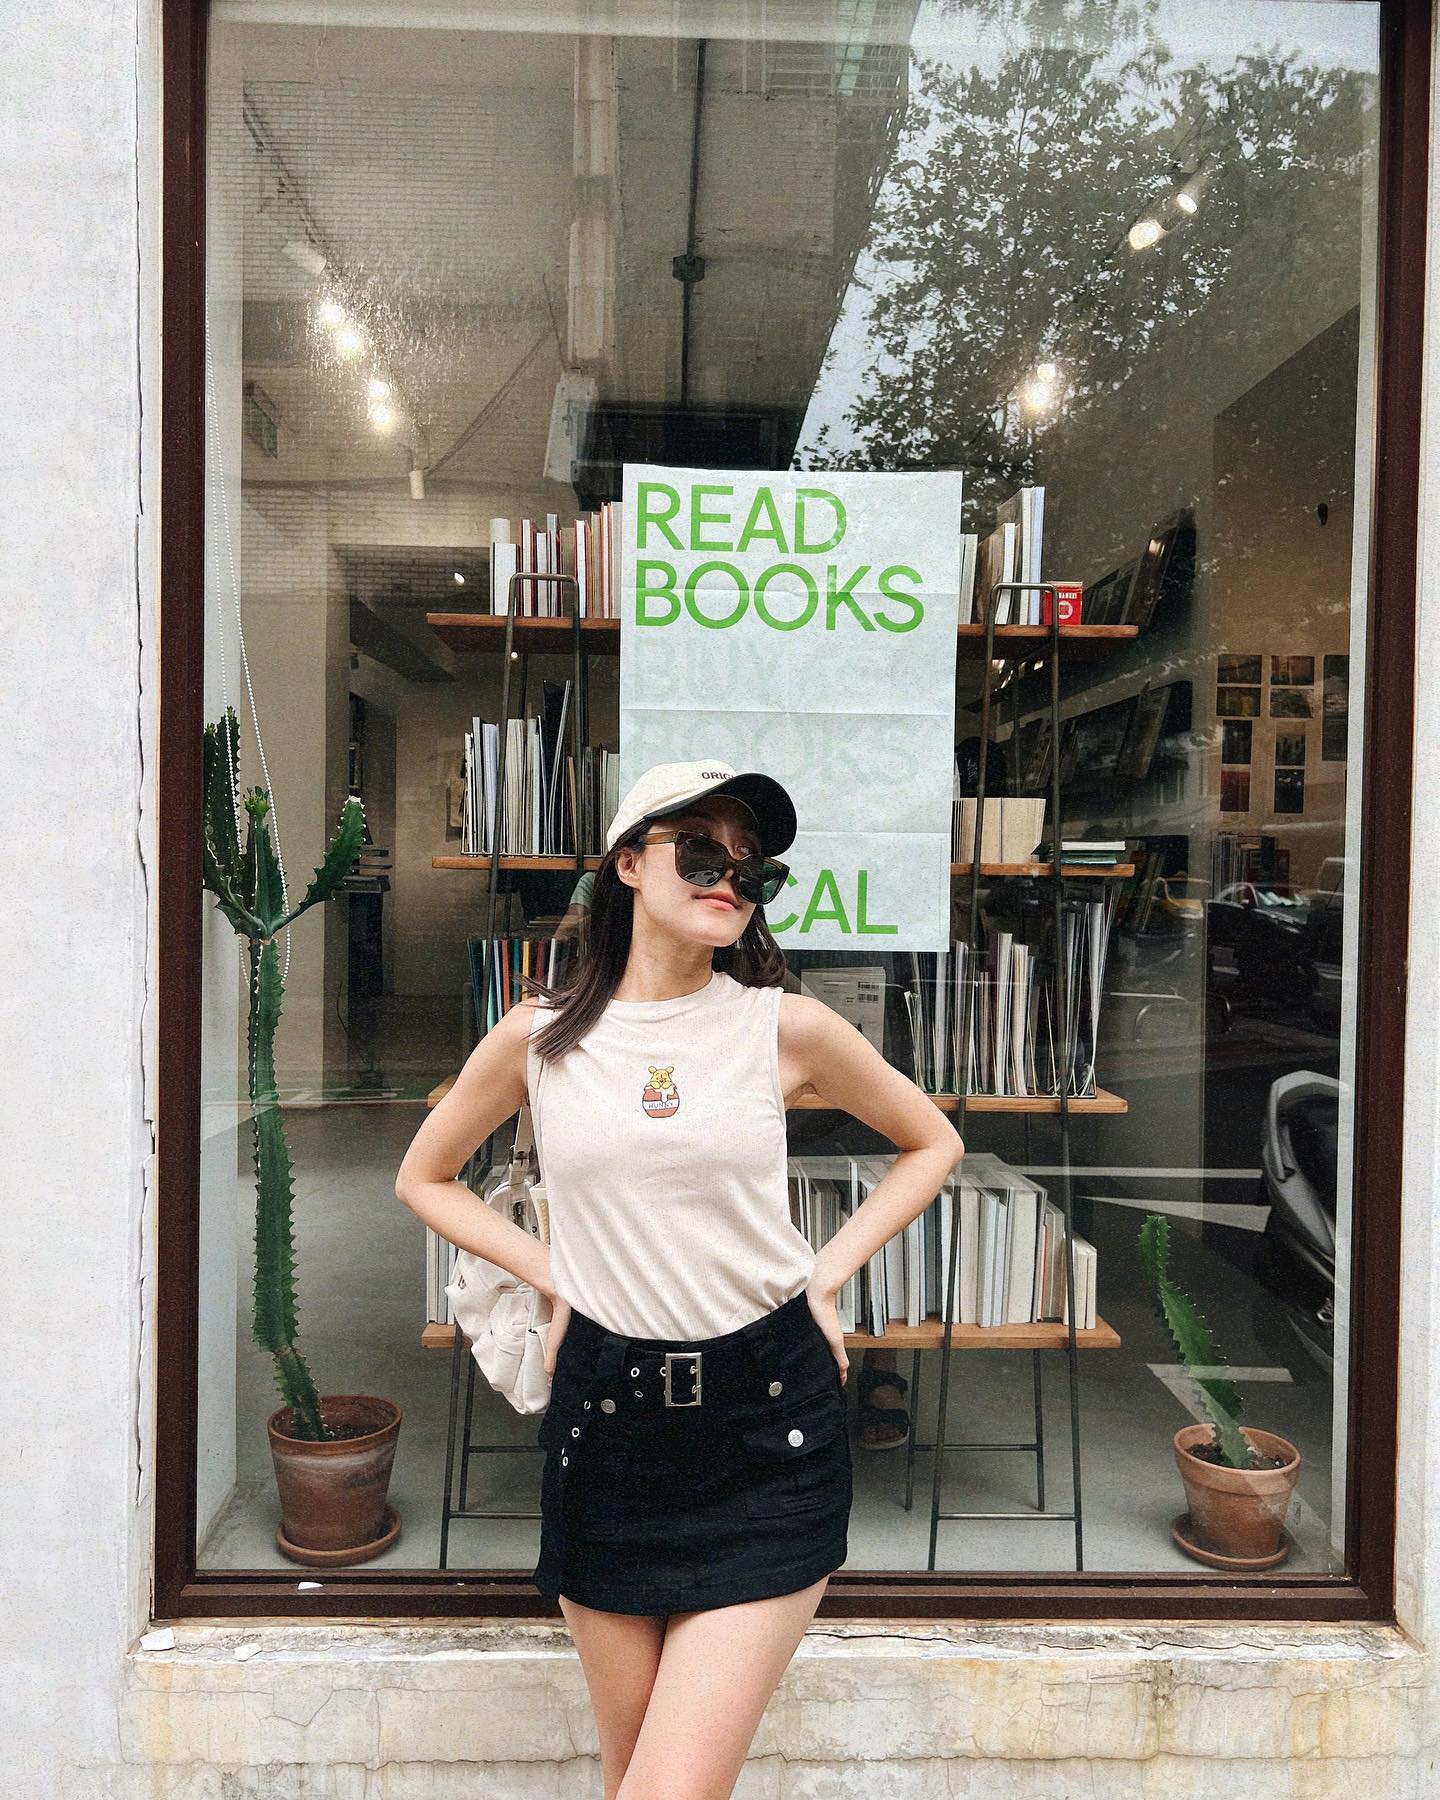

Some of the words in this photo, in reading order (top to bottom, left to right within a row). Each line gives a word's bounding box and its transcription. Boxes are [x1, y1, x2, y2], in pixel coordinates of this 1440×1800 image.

[637, 483, 847, 554] READ
[635, 559, 924, 633] BOOKS
[702, 771, 733, 780] ORIG
